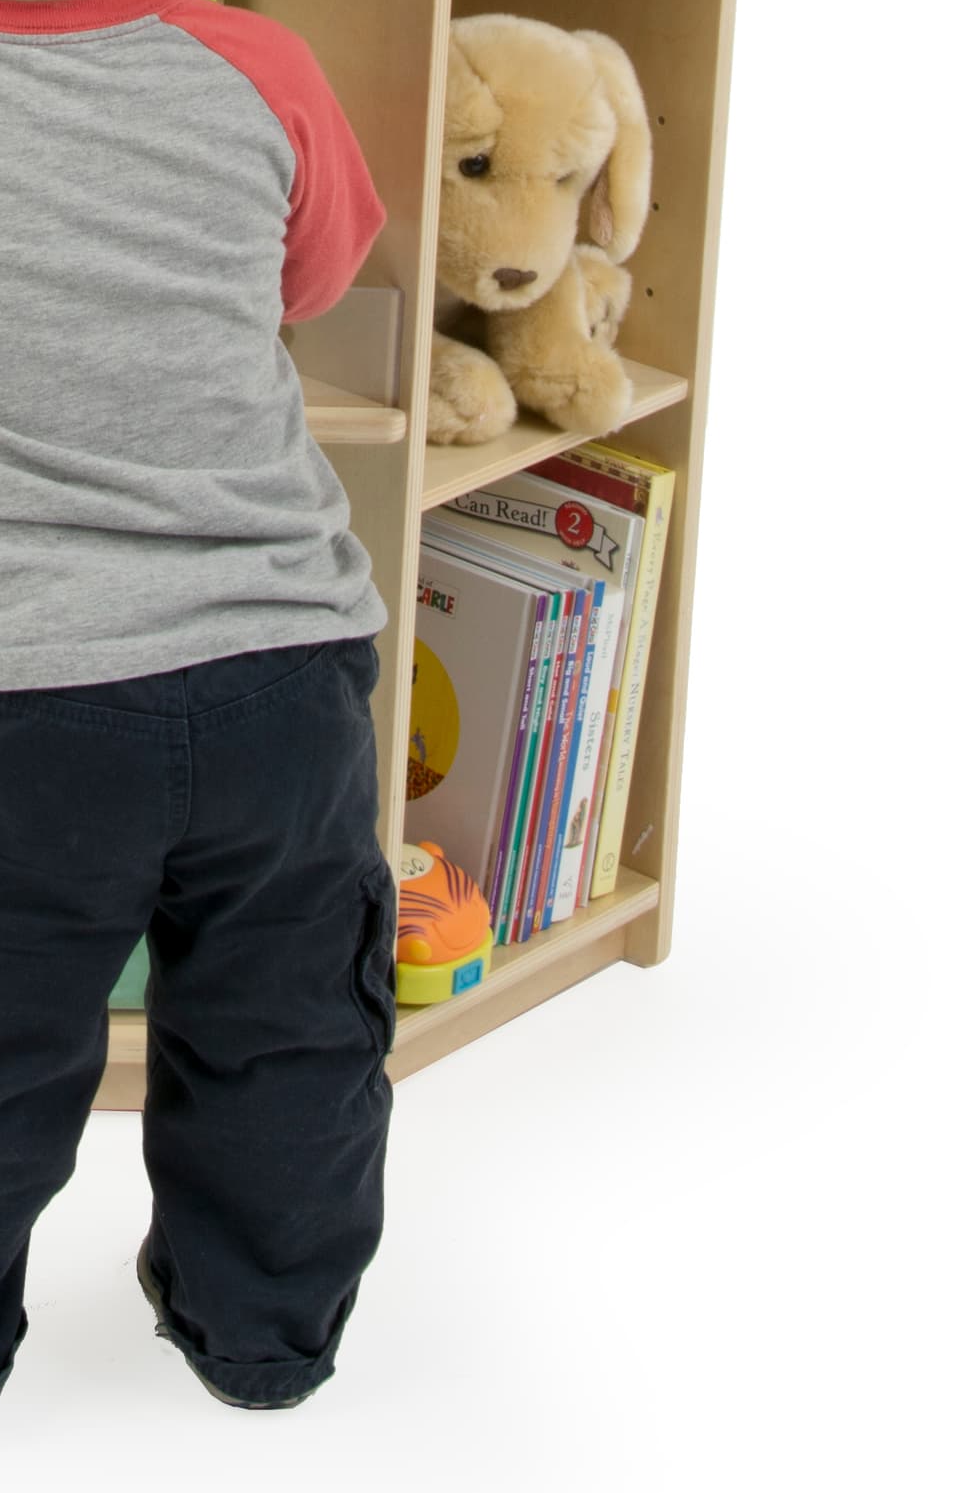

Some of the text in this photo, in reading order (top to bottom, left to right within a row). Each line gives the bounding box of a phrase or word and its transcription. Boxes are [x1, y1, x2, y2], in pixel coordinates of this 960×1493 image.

[495, 499, 548, 528] Read!
[567, 512, 582, 536] 2
[582, 710, 601, 771] Sisters
